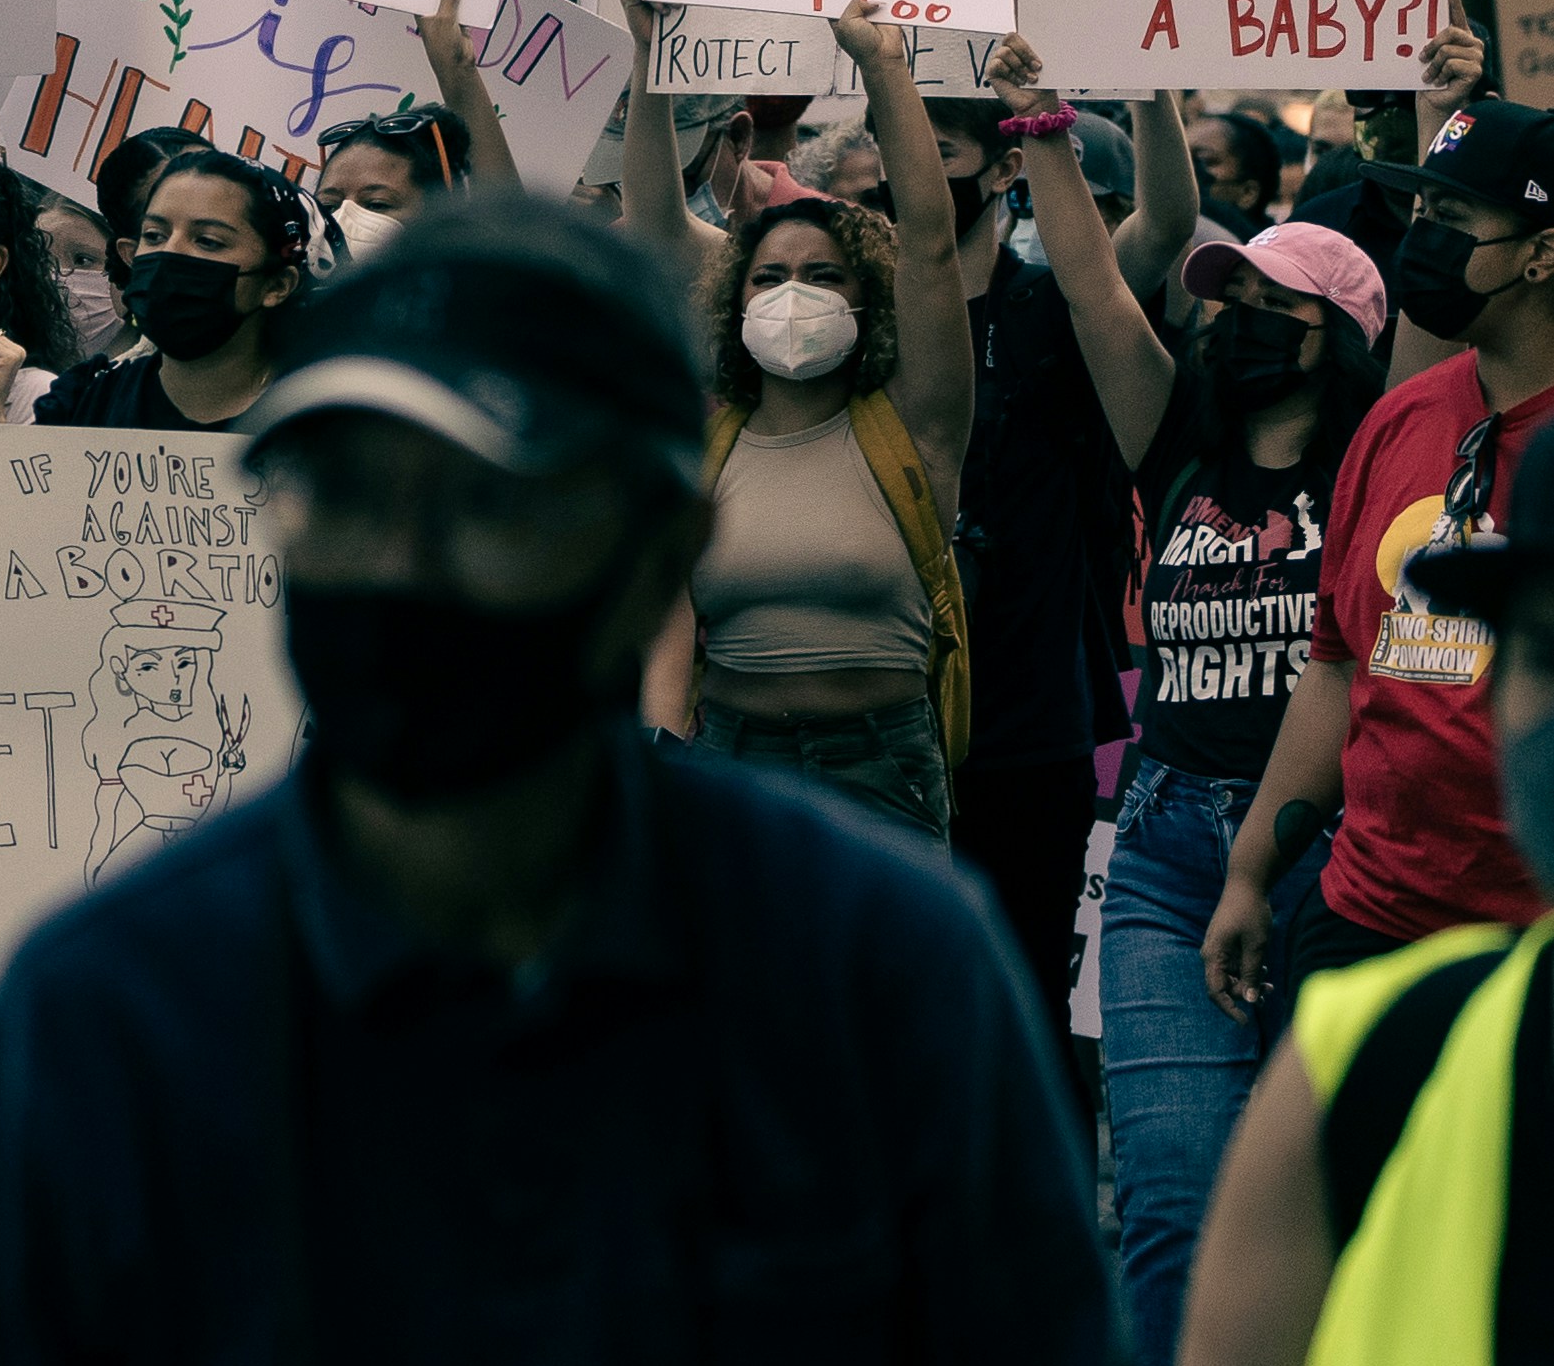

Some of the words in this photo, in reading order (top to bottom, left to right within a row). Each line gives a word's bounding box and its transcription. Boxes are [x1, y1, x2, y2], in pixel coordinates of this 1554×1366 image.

[655, 4, 801, 87] PROTECT
[10, 454, 51, 494] IF
[84, 446, 215, 500] YOU'RE
[82, 501, 257, 546] AGAINST
[5, 546, 283, 609] ABORTIO
[1151, 593, 1316, 640] REPRODUCTIVE
[1387, 645, 1478, 673] POWWOW
